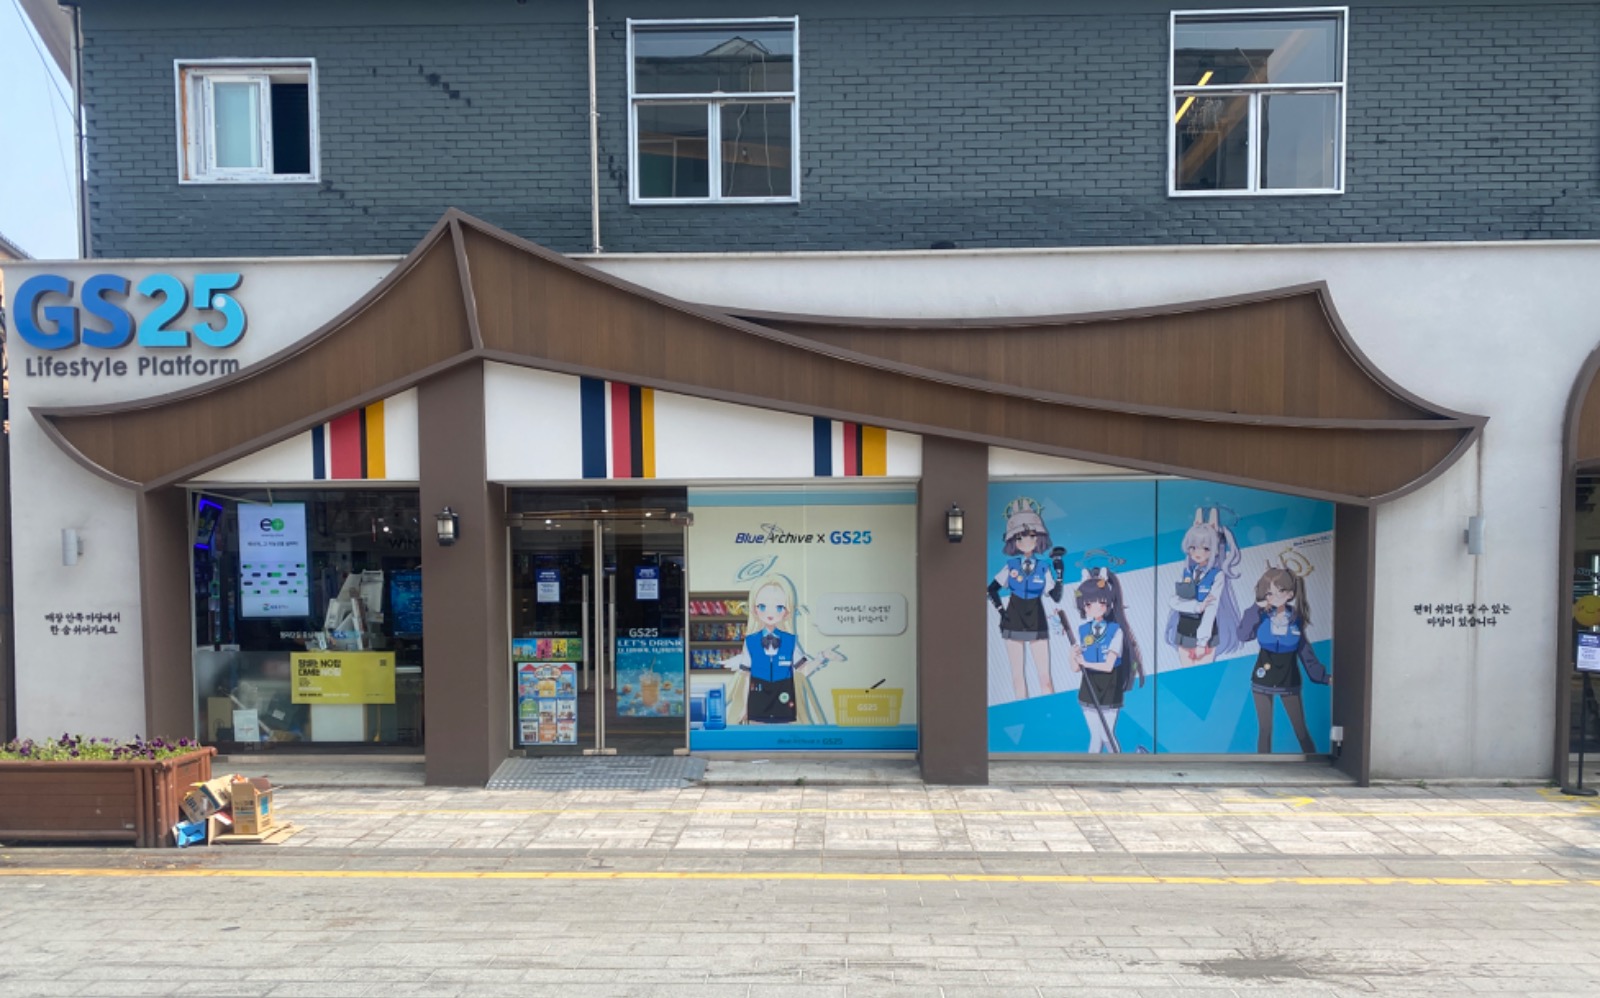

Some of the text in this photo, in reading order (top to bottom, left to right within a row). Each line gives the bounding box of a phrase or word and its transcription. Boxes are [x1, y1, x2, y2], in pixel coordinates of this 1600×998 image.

[13, 272, 248, 350] GS25
[26, 355, 240, 382] Lifestyle Platform
[735, 532, 764, 544] Blue
[764, 529, 814, 545] Archive
[829, 530, 872, 545] GS25
[1414, 603, 1511, 615] 편히 쉬었다 갈 수 있는
[44, 612, 120, 624] 매장 안쪽 마당에서
[1427, 616, 1497, 627] 마당이 있습니다
[50, 625, 59, 635] 한
[629, 627, 658, 638] GS25
[617, 639, 683, 647] LET'S DRINK
[857, 703, 878, 712] GS25
